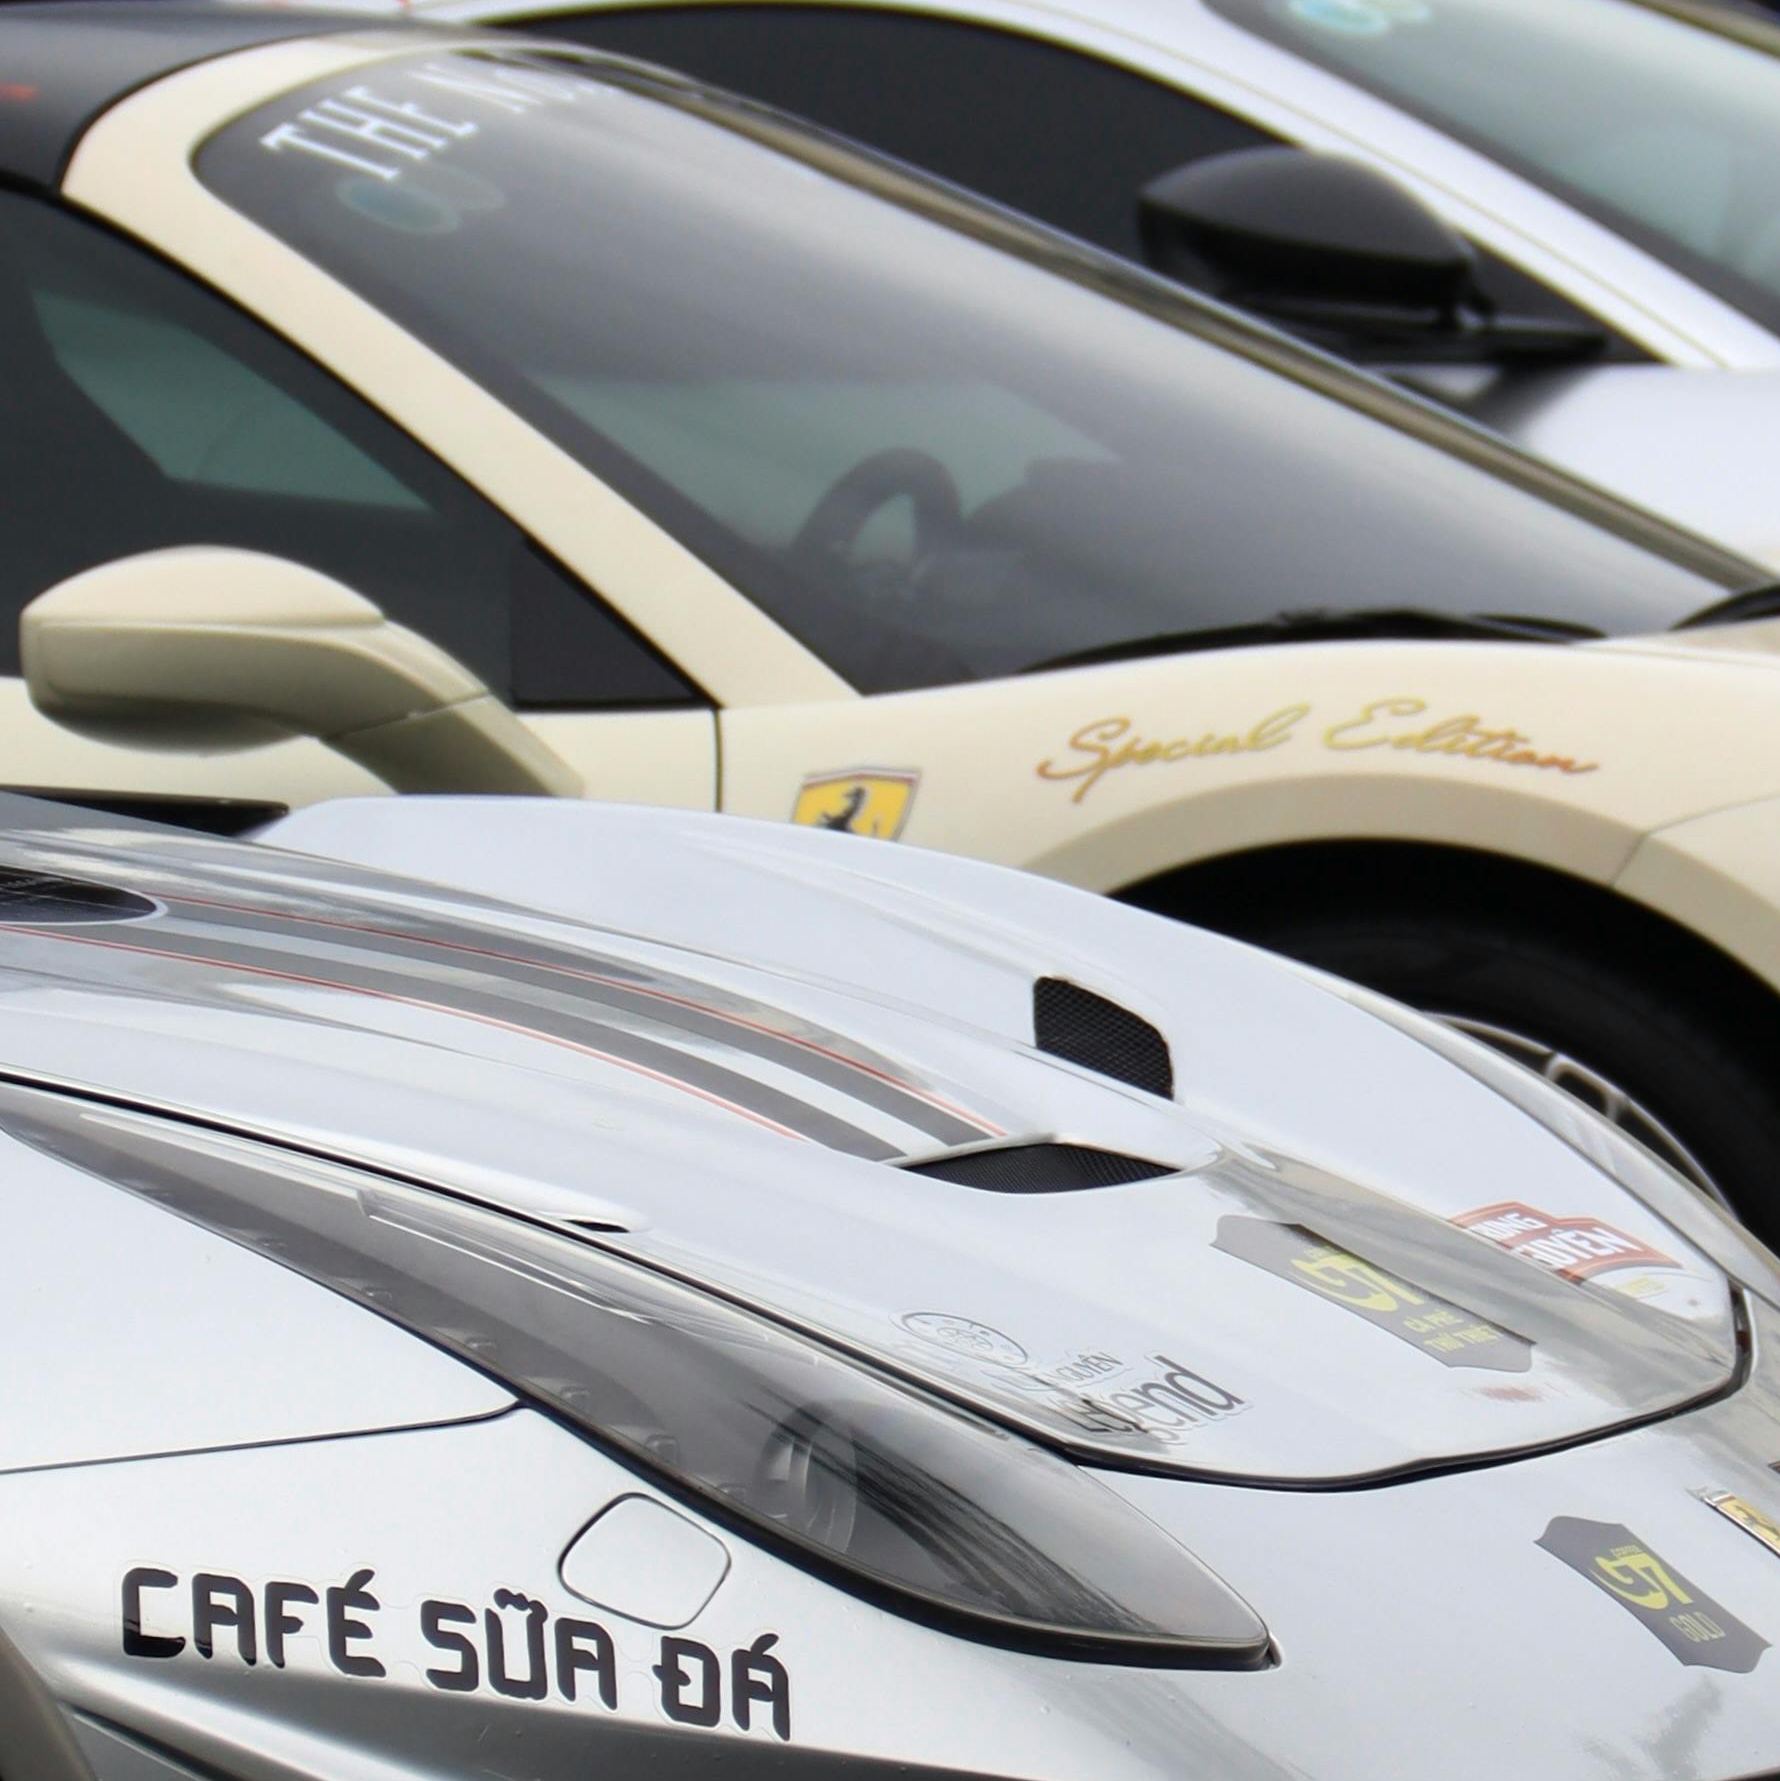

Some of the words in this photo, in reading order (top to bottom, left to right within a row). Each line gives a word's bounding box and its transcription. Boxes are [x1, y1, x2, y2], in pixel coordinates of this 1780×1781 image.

[258, 84, 480, 183] THE
[1035, 702, 1311, 804] Special
[1323, 697, 1602, 776] Edition
[1287, 1252, 1425, 1312] G7
[1589, 1553, 1694, 1611] G7
[121, 1567, 387, 1678] CAFÉ
[420, 1586, 620, 1713] SỮA
[652, 1631, 793, 1743] ĐÁ
[1668, 1611, 1727, 1644] GOLD
